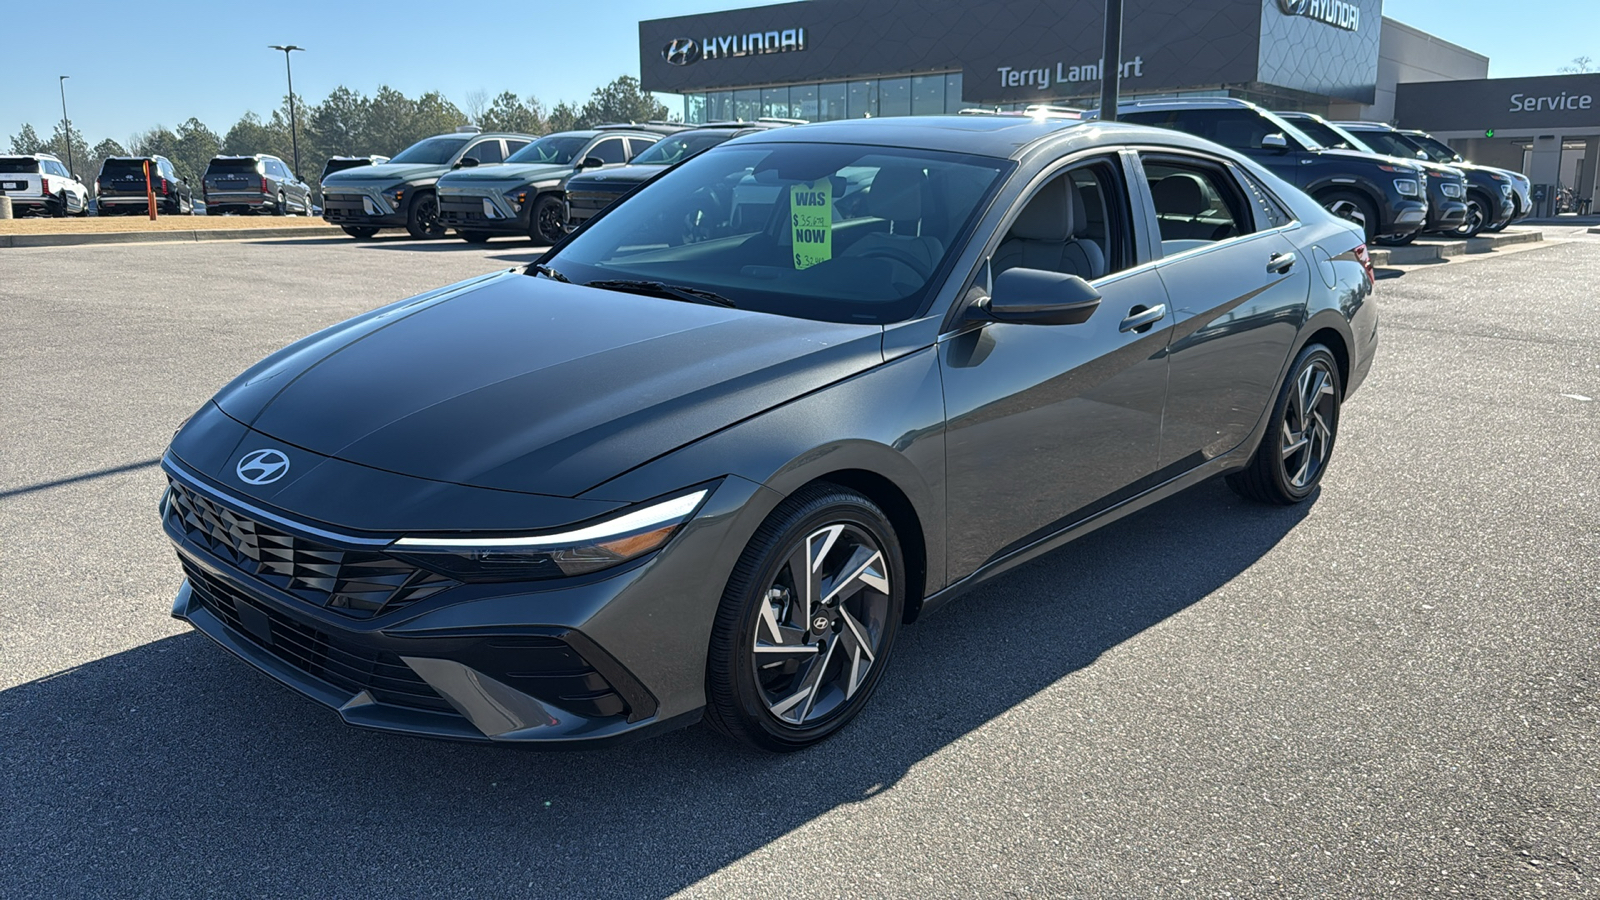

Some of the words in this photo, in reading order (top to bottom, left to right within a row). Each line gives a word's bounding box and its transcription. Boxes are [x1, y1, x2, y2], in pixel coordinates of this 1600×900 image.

[1310, 0, 1360, 32] HYUNDAI
[703, 27, 804, 60] HYUNDAI
[997, 66, 1050, 90] Terry
[1056, 56, 1144, 83] Lamrt
[1509, 91, 1593, 112] Service
[795, 191, 826, 207] WAS
[795, 228, 826, 244] NOW
